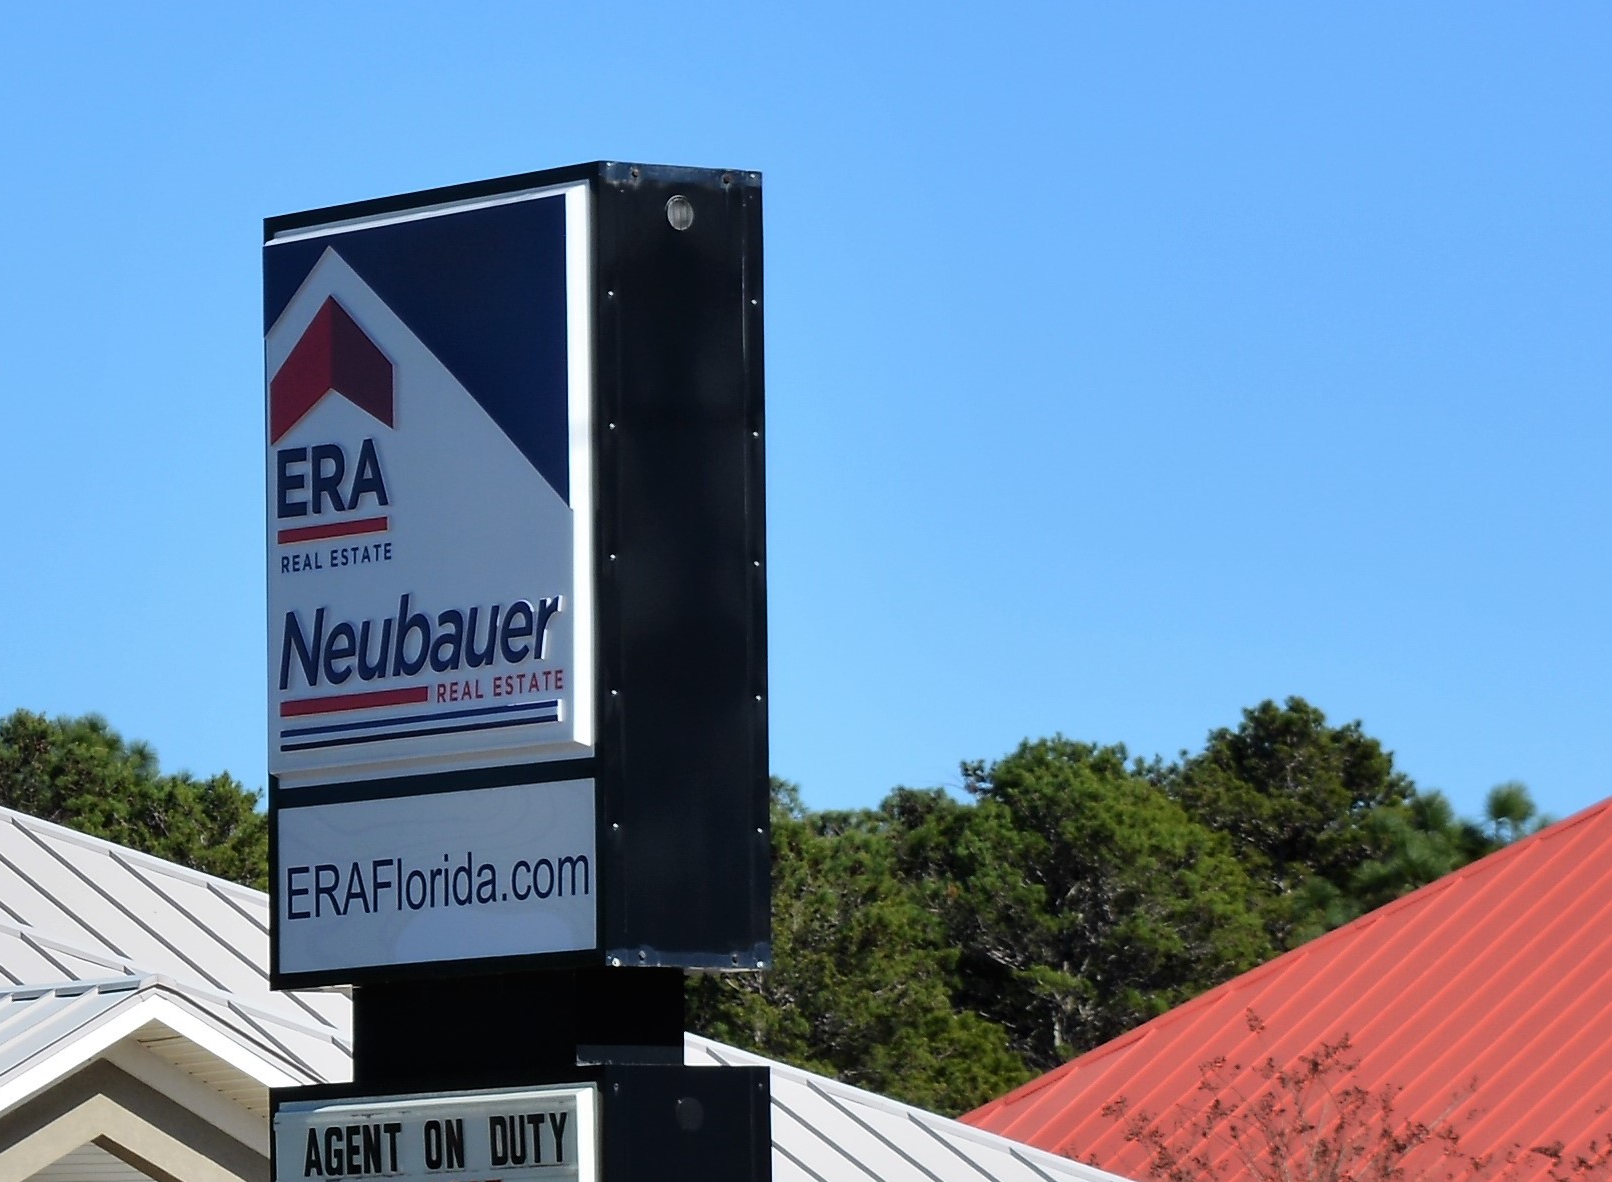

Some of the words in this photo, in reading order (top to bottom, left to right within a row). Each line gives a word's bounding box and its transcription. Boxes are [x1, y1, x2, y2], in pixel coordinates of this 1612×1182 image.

[277, 438, 388, 518] ERA
[281, 552, 322, 573] REAL
[330, 542, 392, 568] ESTATE
[279, 593, 563, 691] Neubauer
[436, 681, 484, 703] REAL
[493, 669, 564, 697] ESTATE
[287, 852, 589, 919] ERAFlorida.com
[304, 1122, 401, 1178] AGENT
[424, 1119, 464, 1170] ON
[490, 1112, 566, 1167] DUTY
